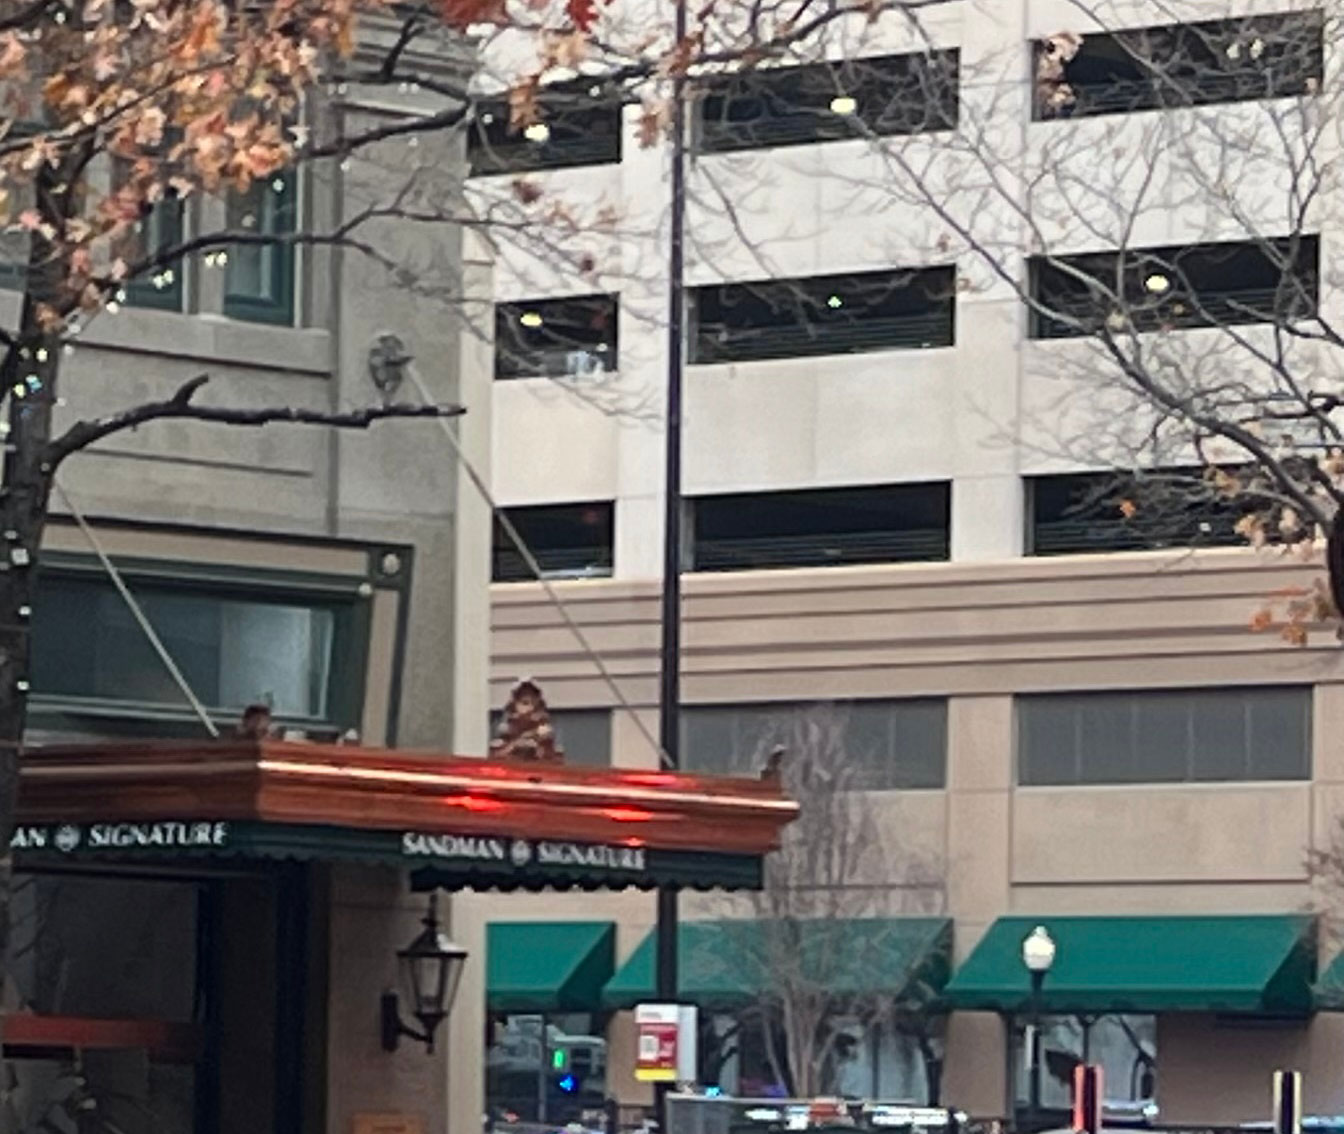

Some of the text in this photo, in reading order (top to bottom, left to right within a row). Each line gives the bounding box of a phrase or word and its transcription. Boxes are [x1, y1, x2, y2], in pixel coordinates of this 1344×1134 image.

[88, 821, 227, 847] SIGNATURE
[403, 832, 645, 871] SANDMAN SIGNATURE
